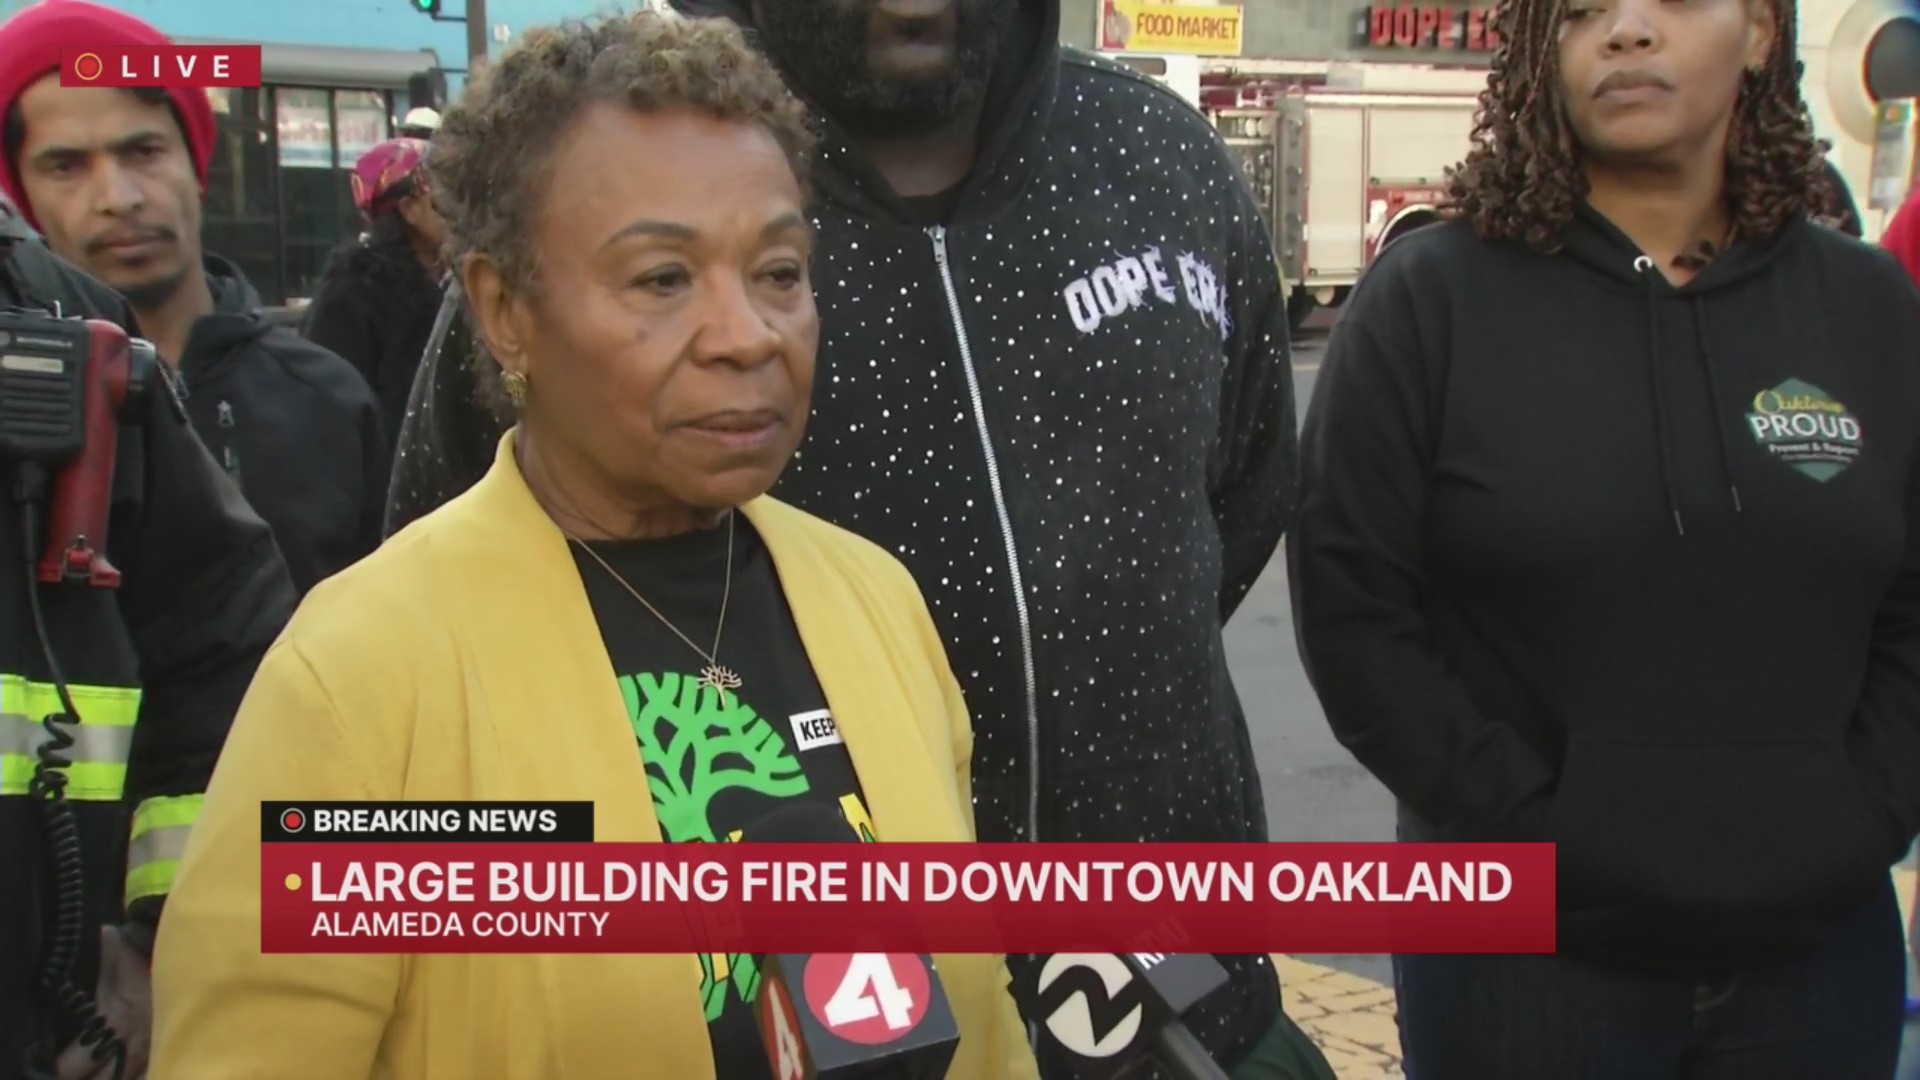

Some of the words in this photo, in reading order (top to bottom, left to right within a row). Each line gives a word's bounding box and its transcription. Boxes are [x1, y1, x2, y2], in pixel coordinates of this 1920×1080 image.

[1136, 12, 1174, 37] FOOD
[1177, 15, 1239, 40] MARKET
[1370, 6, 1457, 49] DOPE
[1063, 245, 1177, 334] DOPE
[1750, 412, 1861, 441] PROUD
[800, 717, 836, 741] KEEP
[824, 940, 914, 1030] 4
